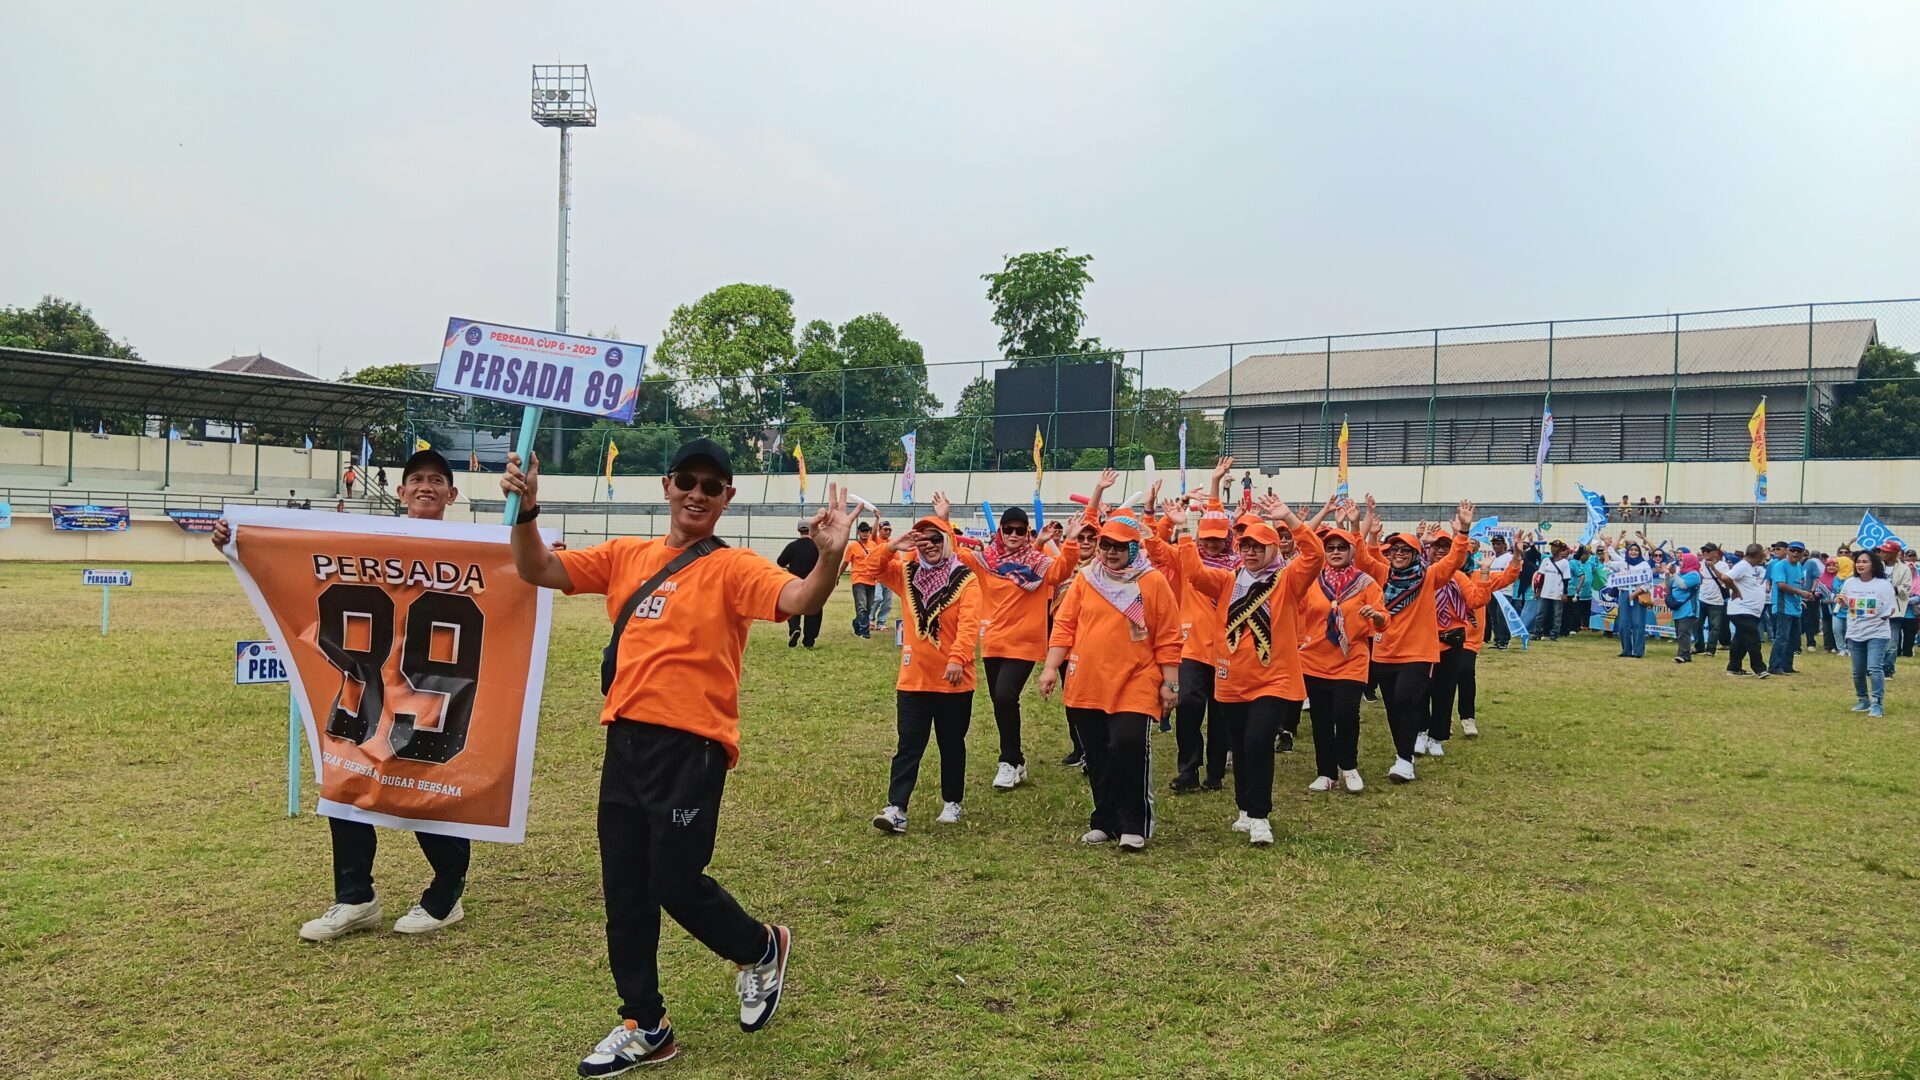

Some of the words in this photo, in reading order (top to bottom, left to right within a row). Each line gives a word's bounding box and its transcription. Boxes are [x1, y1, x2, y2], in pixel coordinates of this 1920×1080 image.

[490, 331, 535, 347] PERSADA
[536, 338, 558, 349] CUP
[558, 342, 565, 351] 6
[572, 344, 597, 356] 2023
[454, 350, 574, 403] PERSADA
[583, 370, 624, 411] 89
[87, 575, 117, 584] PERSADA
[119, 576, 129, 584] 09
[311, 553, 487, 595] PERSADA
[1610, 575, 1638, 586] PERSADA
[635, 595, 667, 619] 89
[248, 658, 288, 680] PERS
[316, 582, 486, 765] 89
[322, 752, 343, 767] RAK
[343, 760, 380, 782] BERSAM
[381, 775, 415, 789] BUGAR
[417, 780, 462, 797] BERSAMA
